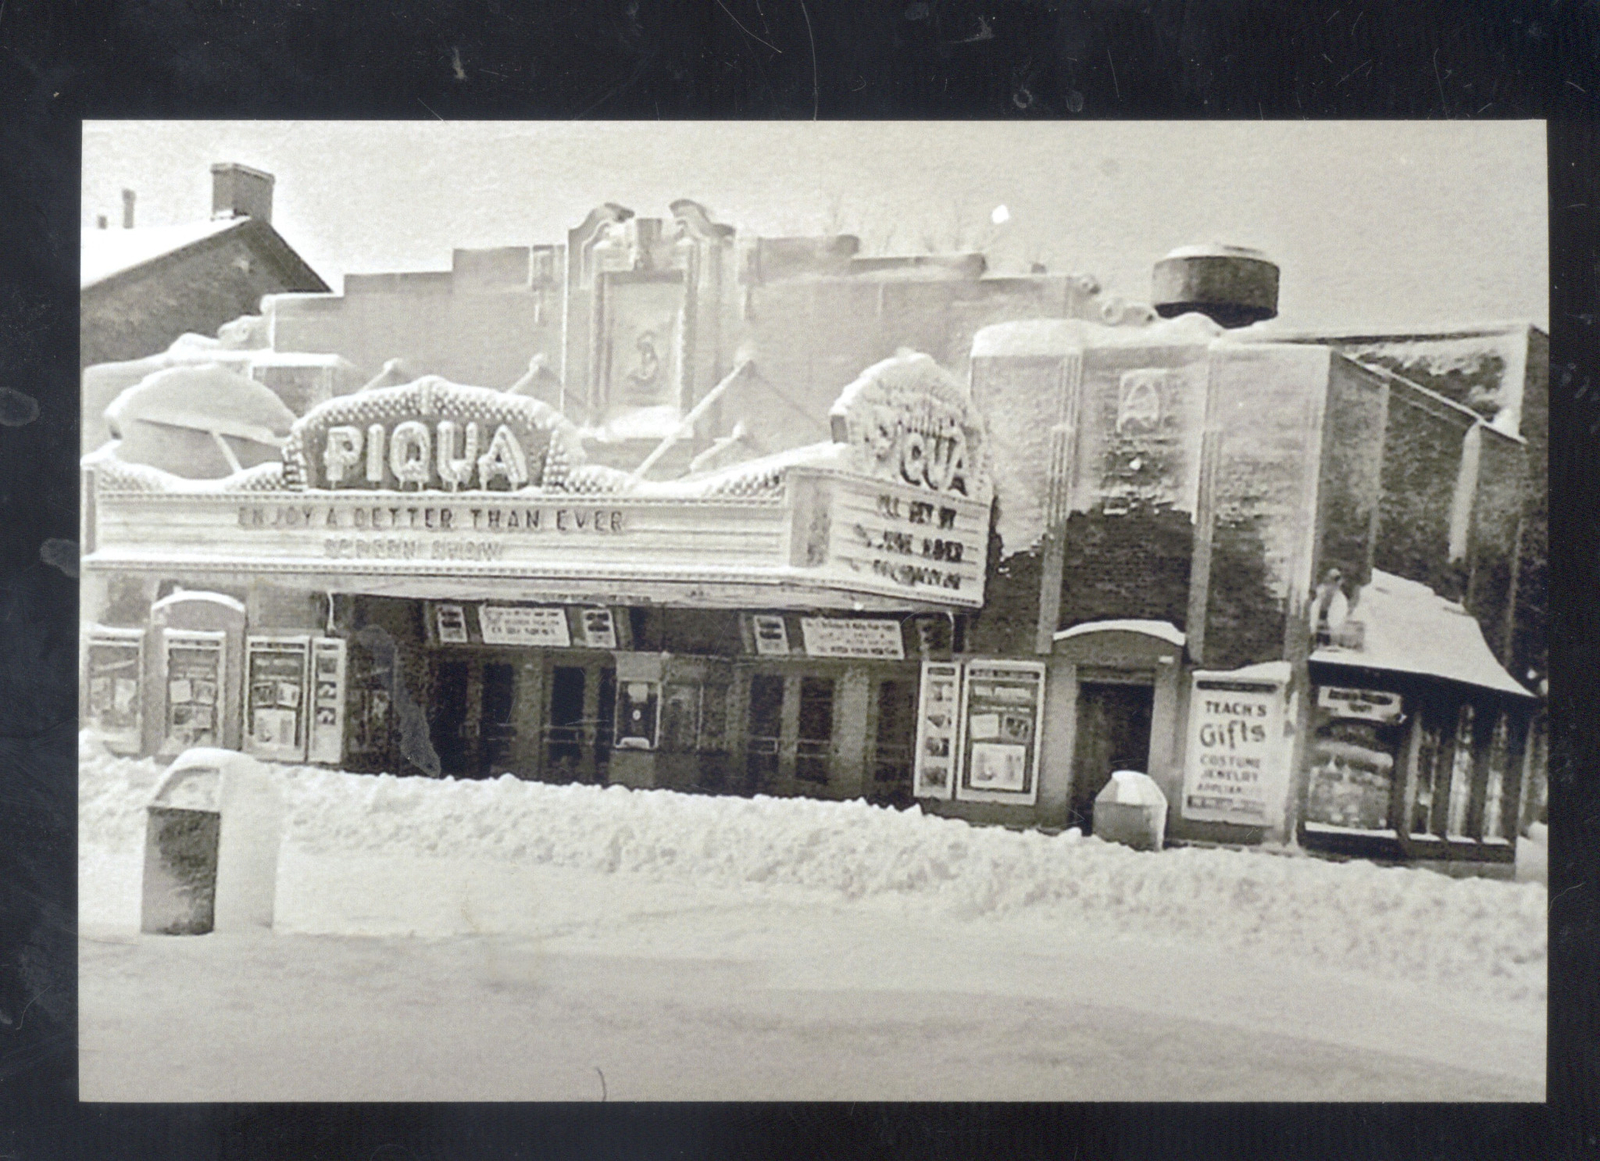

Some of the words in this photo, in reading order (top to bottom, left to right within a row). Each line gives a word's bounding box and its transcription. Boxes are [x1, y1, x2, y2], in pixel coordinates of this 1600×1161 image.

[323, 420, 529, 485] PIQUA
[238, 505, 315, 528] ENJOY
[325, 507, 339, 528] A
[353, 506, 453, 530] BETTER
[469, 508, 541, 530] THAN
[555, 508, 624, 532] EVER
[1200, 719, 1267, 750] Gifts
